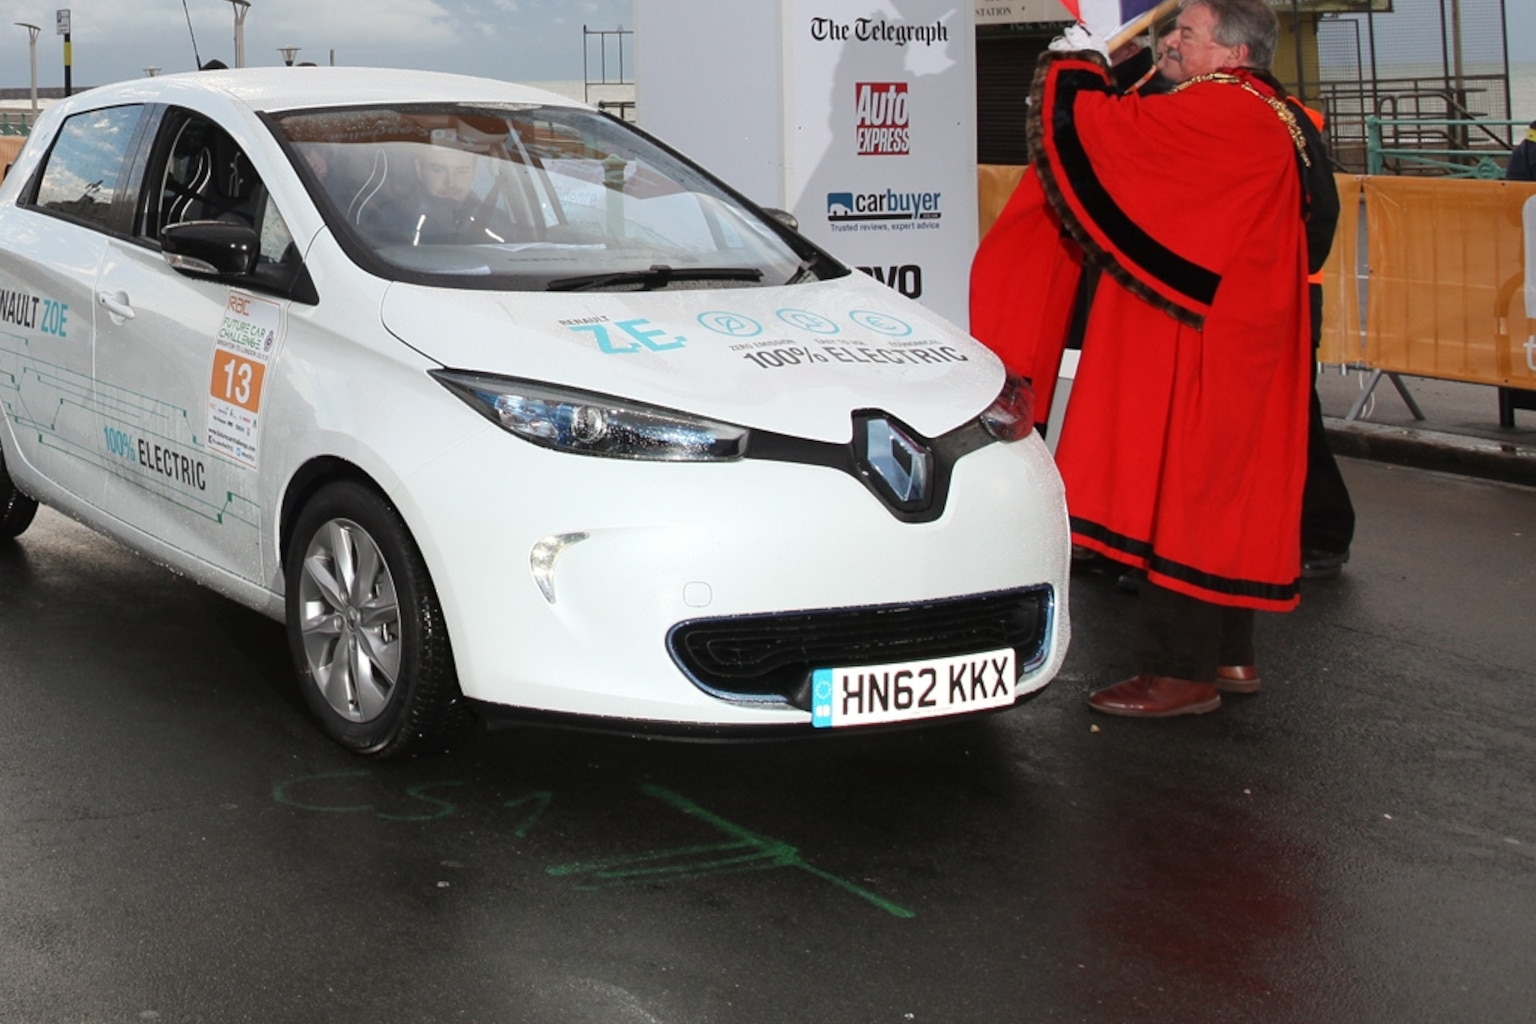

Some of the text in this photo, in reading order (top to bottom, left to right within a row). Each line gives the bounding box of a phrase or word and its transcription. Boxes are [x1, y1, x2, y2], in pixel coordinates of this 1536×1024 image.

[975, 7, 1012, 17] STATION
[811, 17, 948, 46] The Telegraph
[857, 85, 909, 126] Auto
[857, 127, 909, 153] EXPRESS
[855, 188, 941, 219] carbuyer
[830, 221, 940, 232] Trusted reviews, expert advice
[40, 299, 69, 338] ZOE
[223, 317, 267, 338] FUTURE CAR
[558, 315, 610, 326] RENAULT
[219, 328, 262, 350] CHALLENGE
[743, 346, 968, 369] 100% ELECTRIC
[224, 358, 254, 404] 13
[103, 426, 206, 491] 100% ELECTRIC
[842, 656, 1009, 715] HN62 KKX
